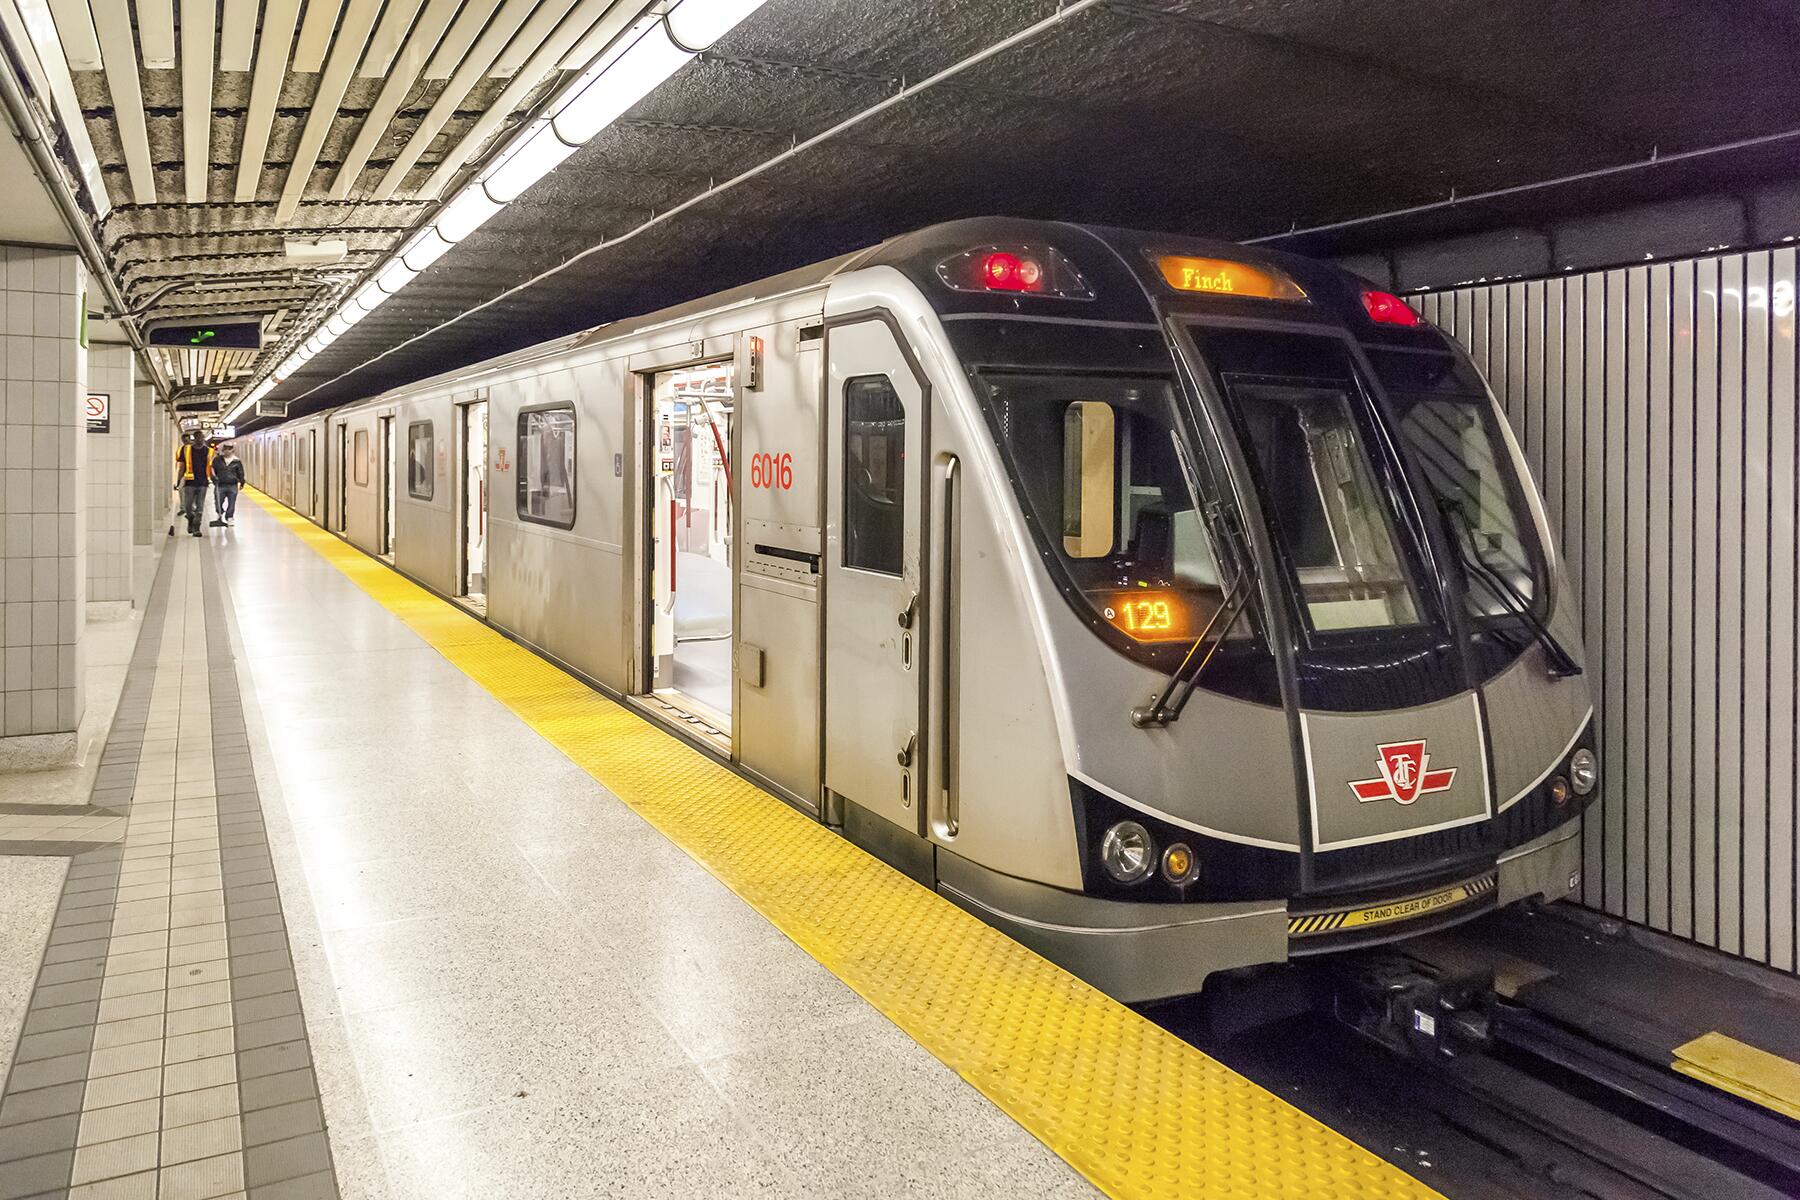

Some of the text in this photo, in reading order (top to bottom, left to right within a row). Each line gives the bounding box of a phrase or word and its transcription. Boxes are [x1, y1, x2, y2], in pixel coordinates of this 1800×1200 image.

[1182, 268, 1233, 291] Finch
[751, 452, 793, 490] 6016
[1122, 601, 1171, 630] 129
[1363, 892, 1453, 921] STAND CLEAR OF DOOR
